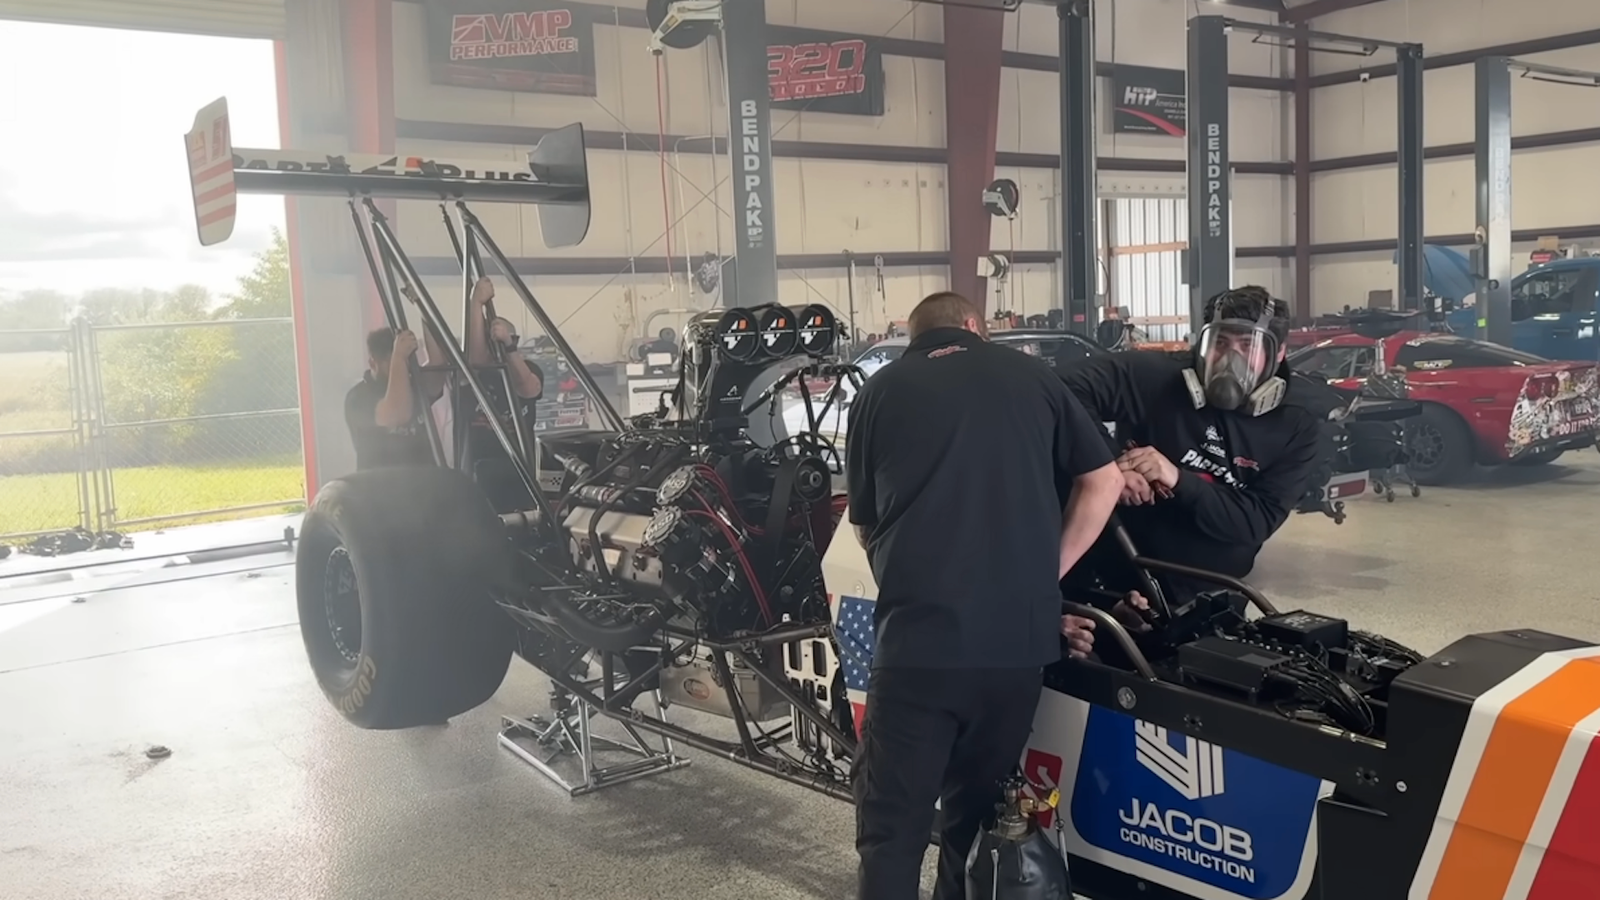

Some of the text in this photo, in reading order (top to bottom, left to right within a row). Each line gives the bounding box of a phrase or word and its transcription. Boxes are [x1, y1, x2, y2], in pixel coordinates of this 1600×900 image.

[451, 37, 575, 60] PERFORMANCE
[482, 9, 572, 42] VMP
[741, 100, 763, 227] BENDPAK
[1207, 123, 1221, 221] BENDPAK
[1180, 449, 1227, 477] PARTS
[1118, 797, 1254, 861] JACOB
[1119, 827, 1255, 883] CONSTRUCTION
